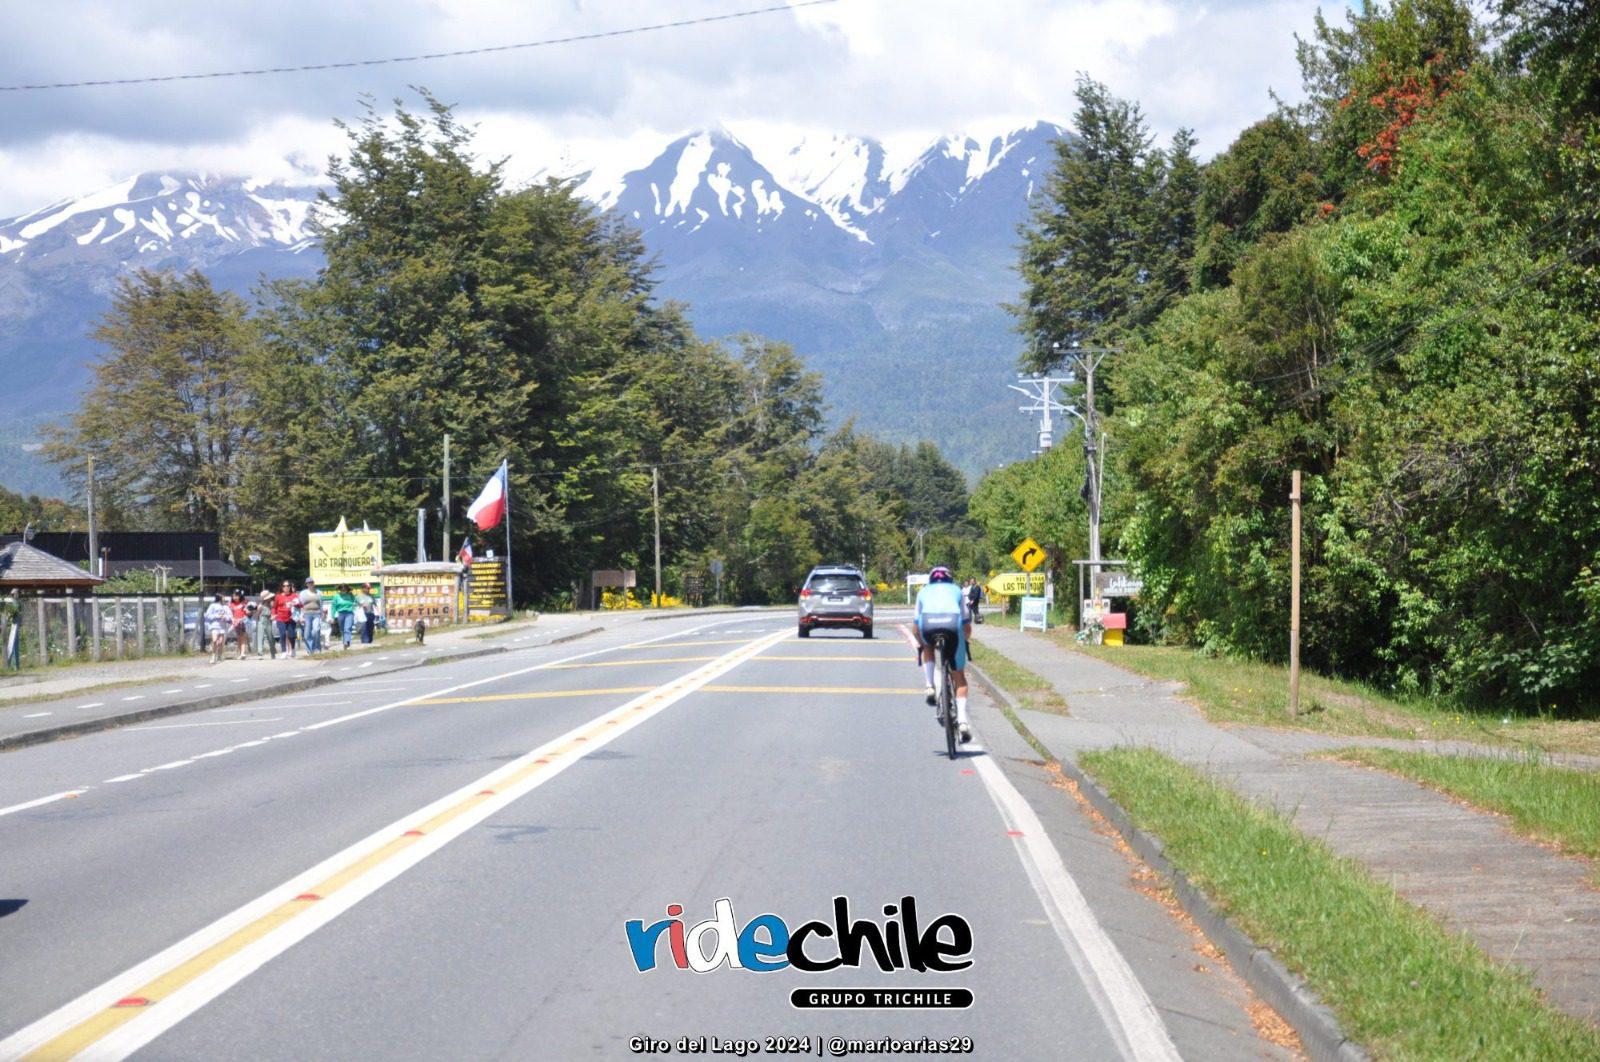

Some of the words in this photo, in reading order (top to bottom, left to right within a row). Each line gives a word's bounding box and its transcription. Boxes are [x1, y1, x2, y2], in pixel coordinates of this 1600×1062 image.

[313, 557, 328, 569] LAS
[387, 573, 444, 585] RESTAURANT
[1002, 582, 1016, 592] LAS
[389, 606, 450, 617] RAFTING
